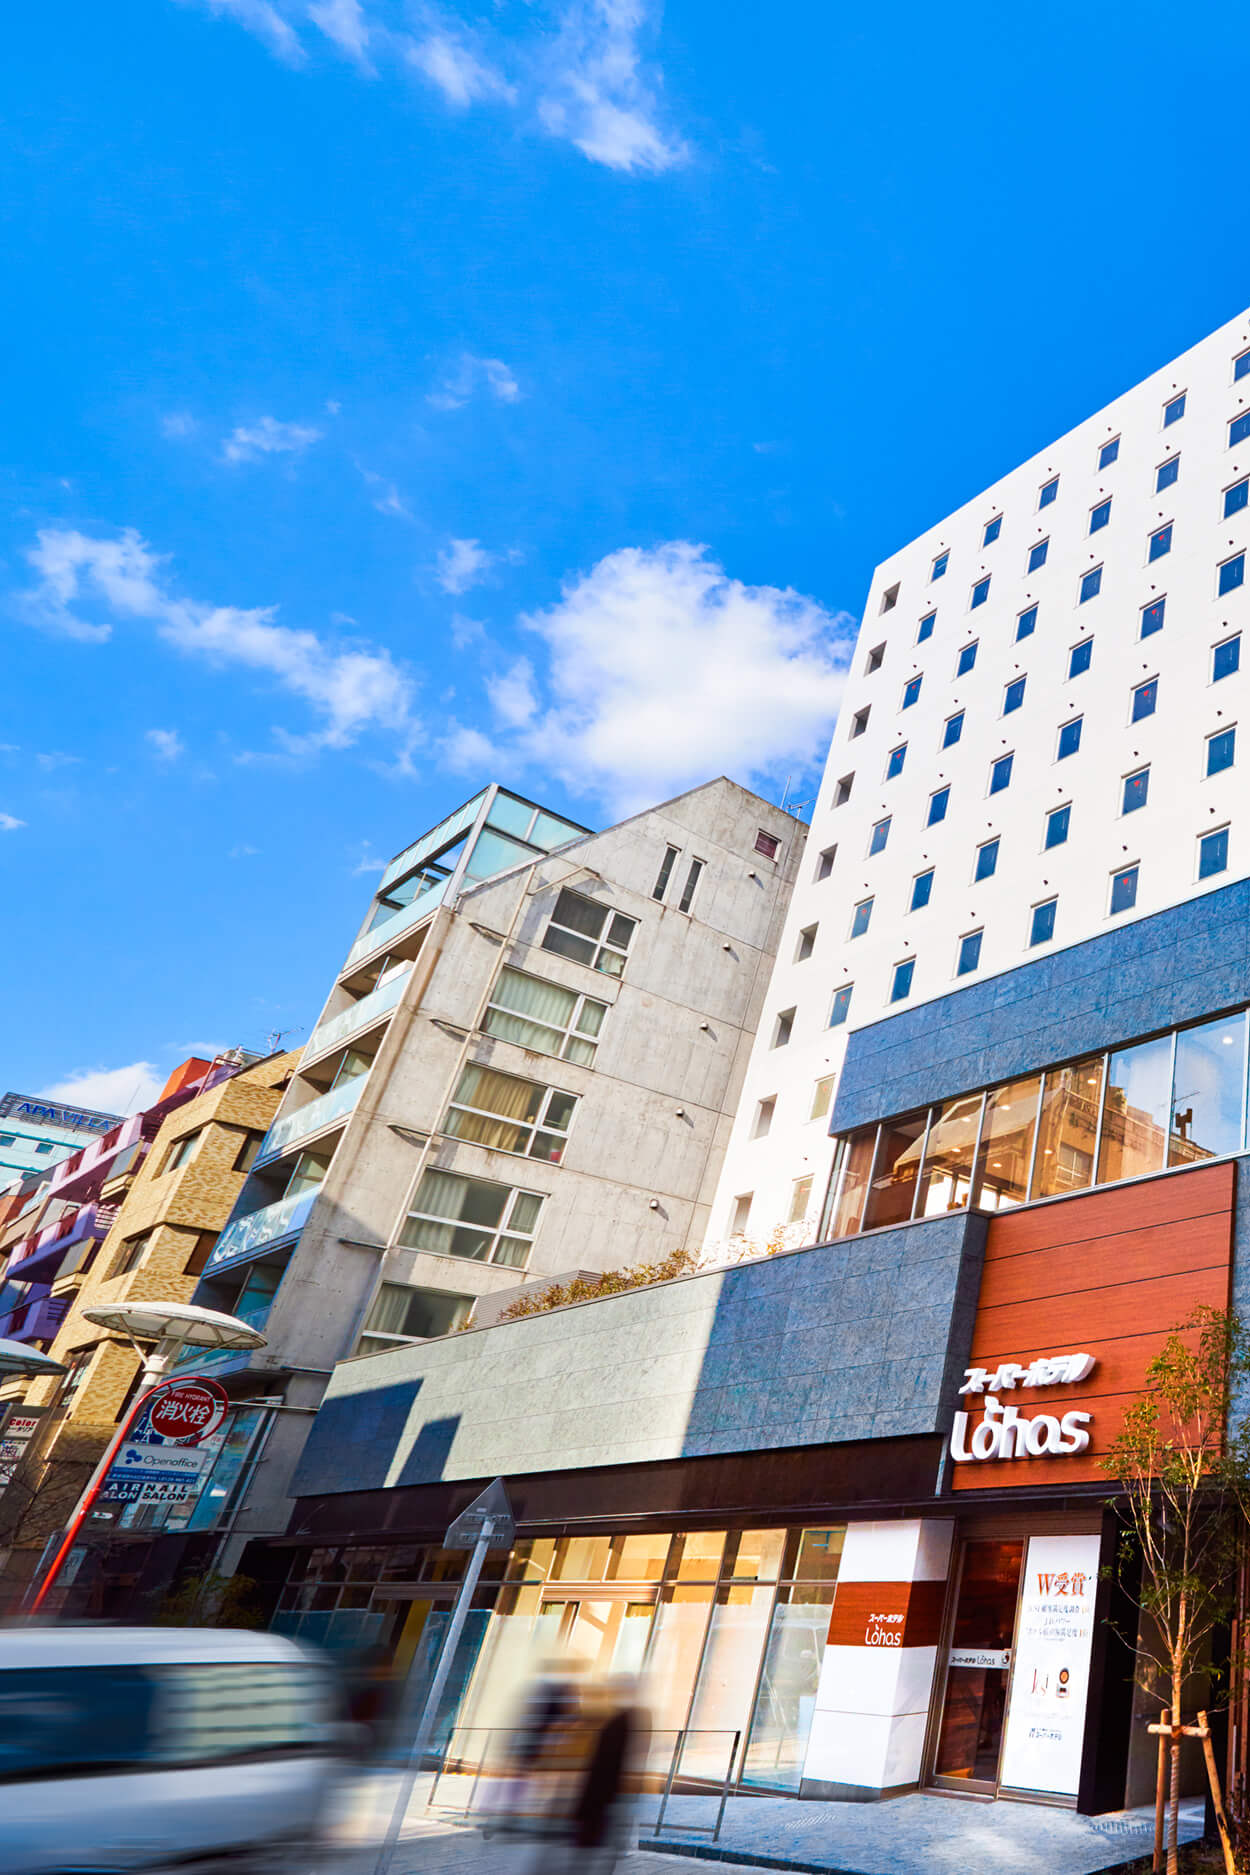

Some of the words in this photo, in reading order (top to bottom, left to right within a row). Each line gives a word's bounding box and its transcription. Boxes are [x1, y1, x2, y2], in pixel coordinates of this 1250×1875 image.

[17, 1102, 55, 1118] APA
[63, 1110, 109, 1130] VILLA
[958, 1353, 1096, 1394] スーパーホテル
[155, 1400, 211, 1424] 消火栓
[951, 1395, 1094, 1461] Lohas
[107, 1482, 140, 1491] AIR
[142, 1492, 187, 1501] SALON
[145, 1483, 188, 1492] NAIL
[1037, 1572, 1087, 1597] W受賞
[864, 1624, 902, 1645] Lohas
[976, 1655, 996, 1666] Lohas
